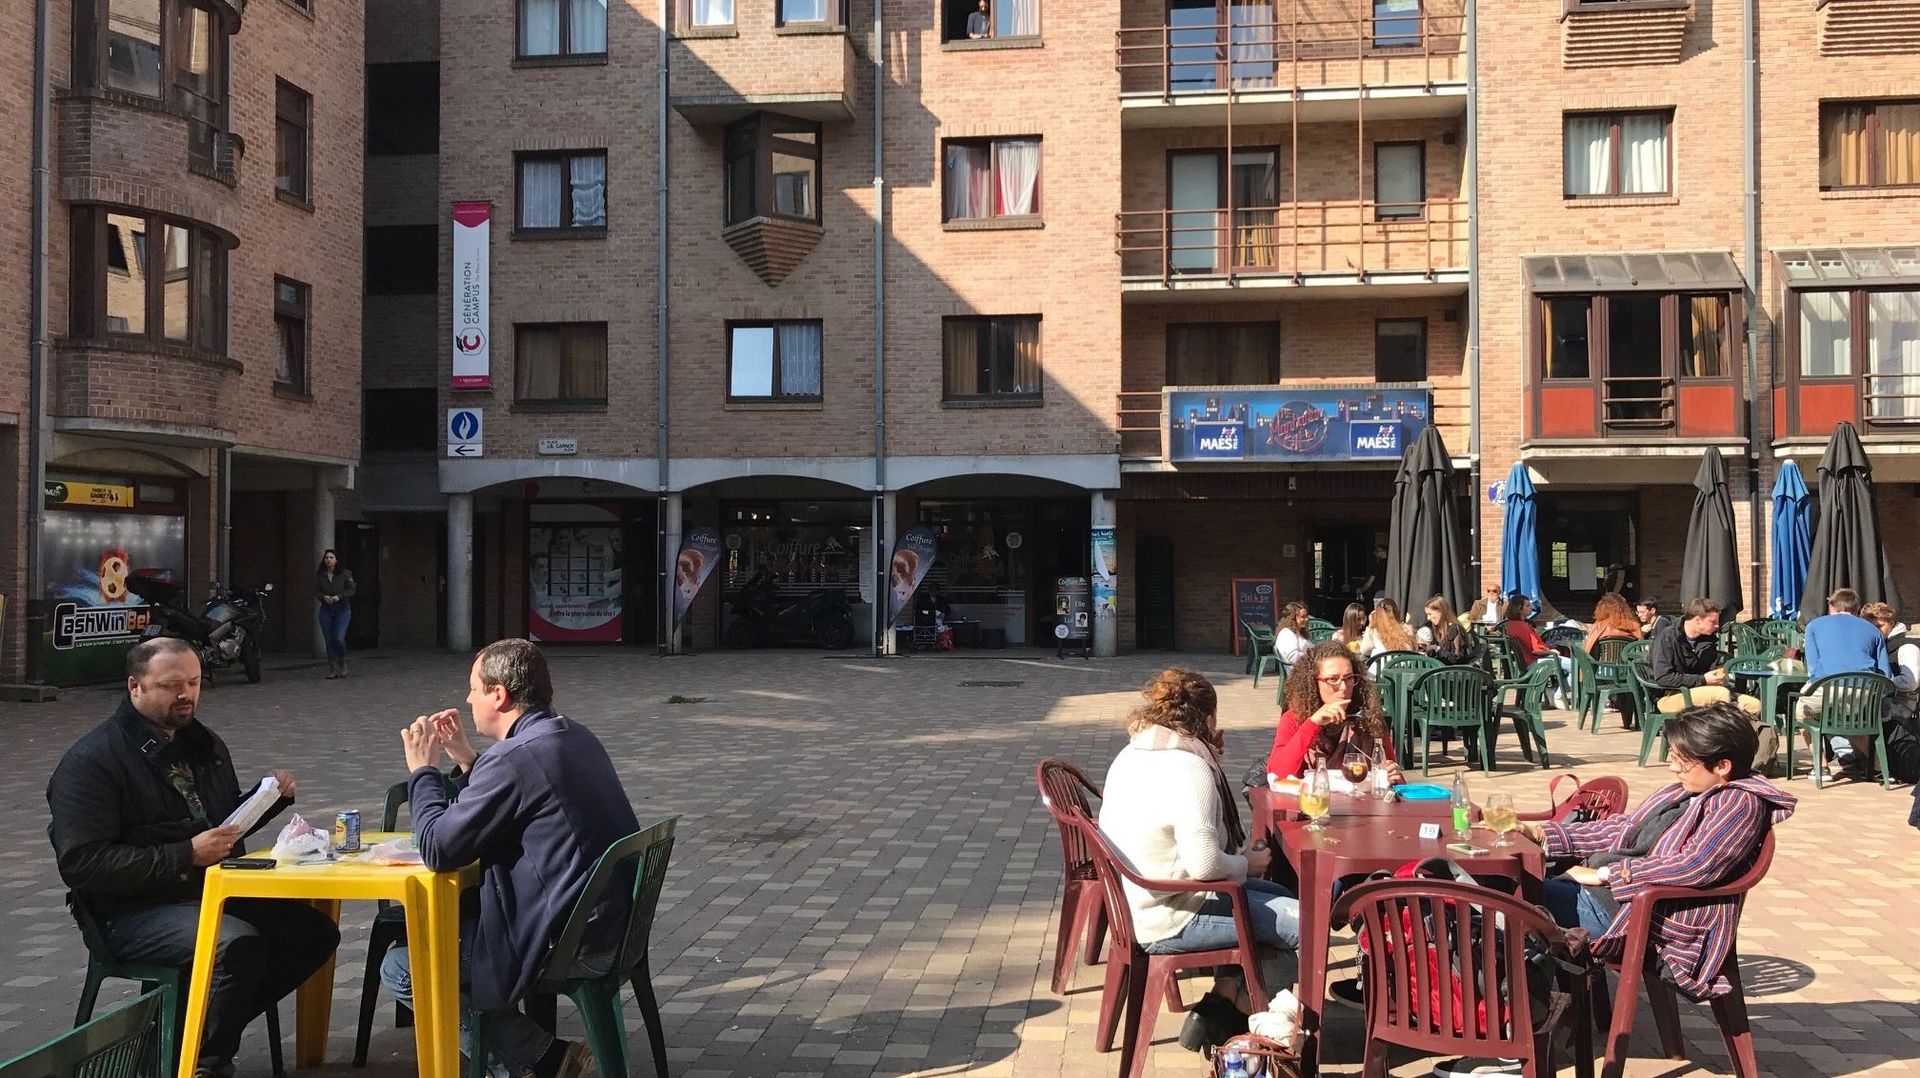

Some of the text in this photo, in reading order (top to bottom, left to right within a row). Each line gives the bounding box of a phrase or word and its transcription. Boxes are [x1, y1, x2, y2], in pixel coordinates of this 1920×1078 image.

[462, 262, 471, 324] GÉNÉRATION
[472, 284, 480, 324] CAMPUS
[1200, 438, 1233, 450] MAES
[1357, 437, 1390, 449] MAES
[691, 533, 717, 545] Coiffure
[906, 533, 933, 545] Coiffure
[1424, 826, 1436, 835] 19
